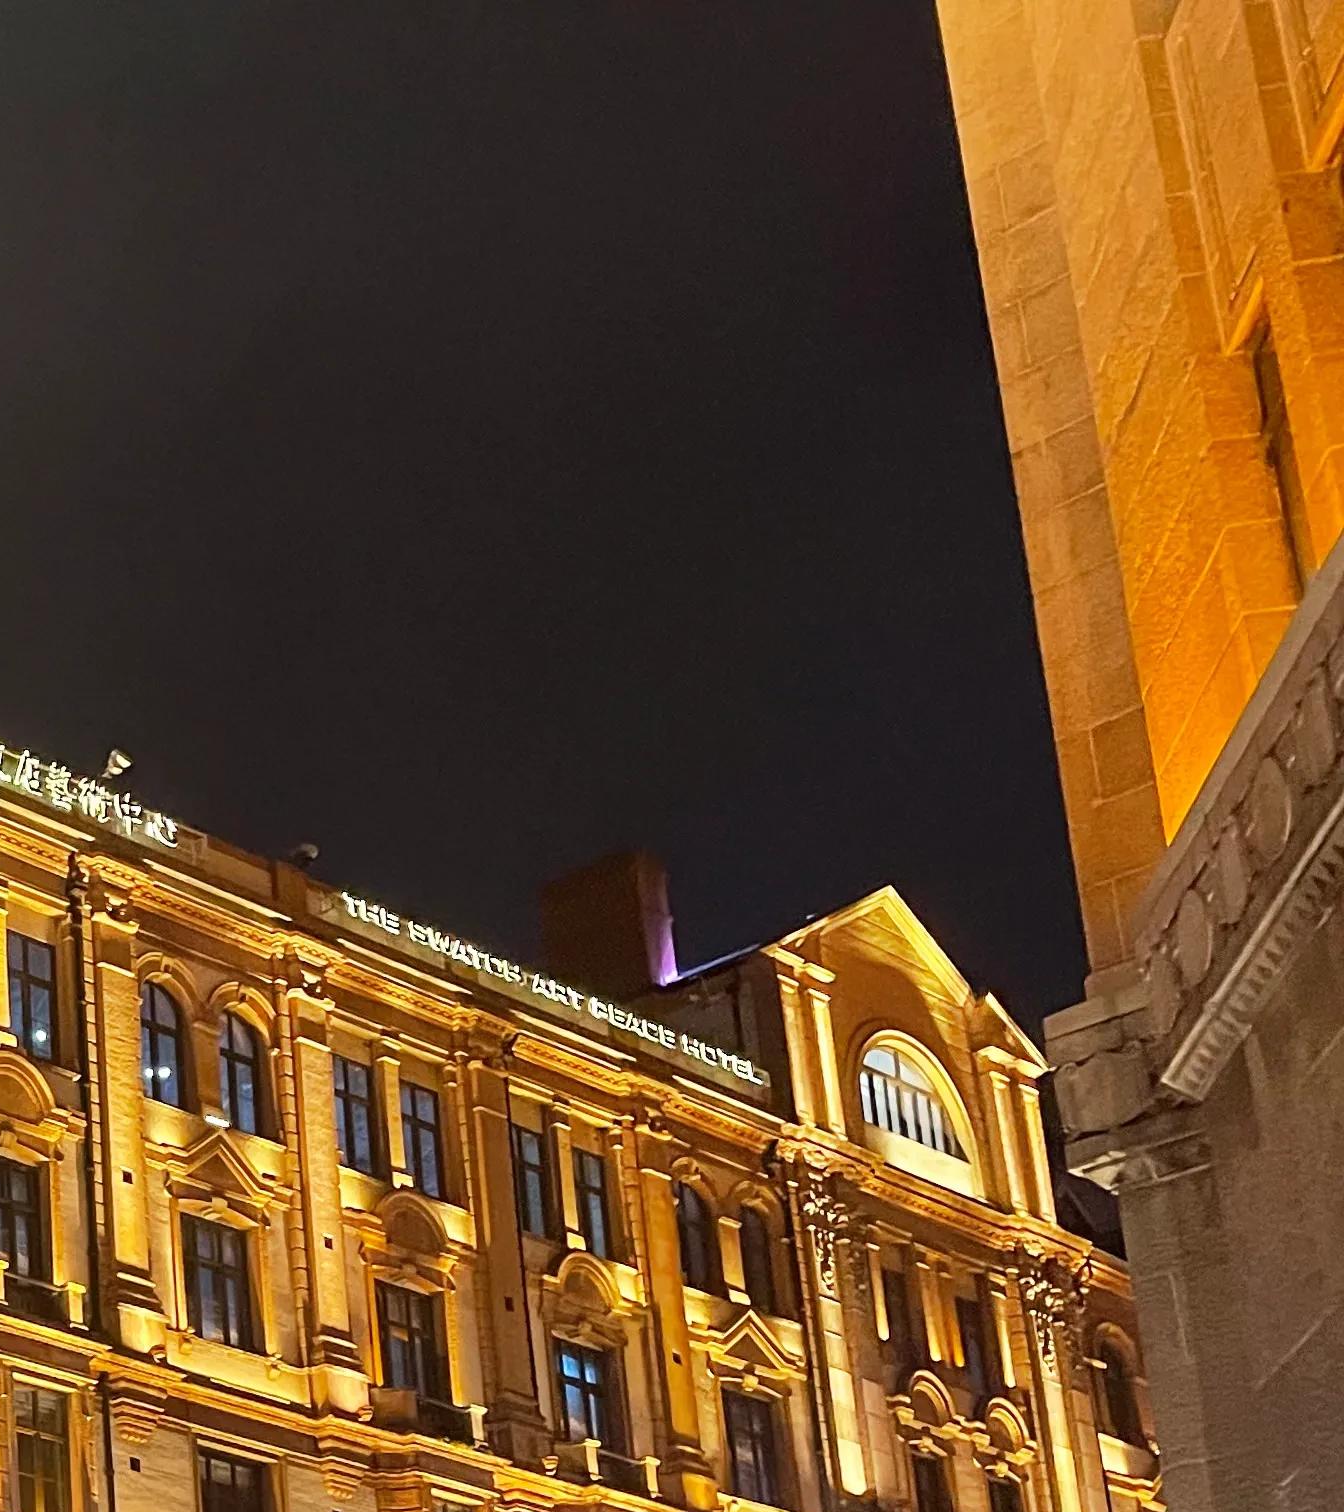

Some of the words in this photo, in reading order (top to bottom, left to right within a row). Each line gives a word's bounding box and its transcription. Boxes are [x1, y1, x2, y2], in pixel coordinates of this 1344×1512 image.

[341, 891, 400, 935] THE
[407, 920, 522, 983] SWATCH
[531, 973, 585, 1011] ART
[588, 995, 677, 1050] PEACE
[680, 1033, 764, 1086] HOTEL
